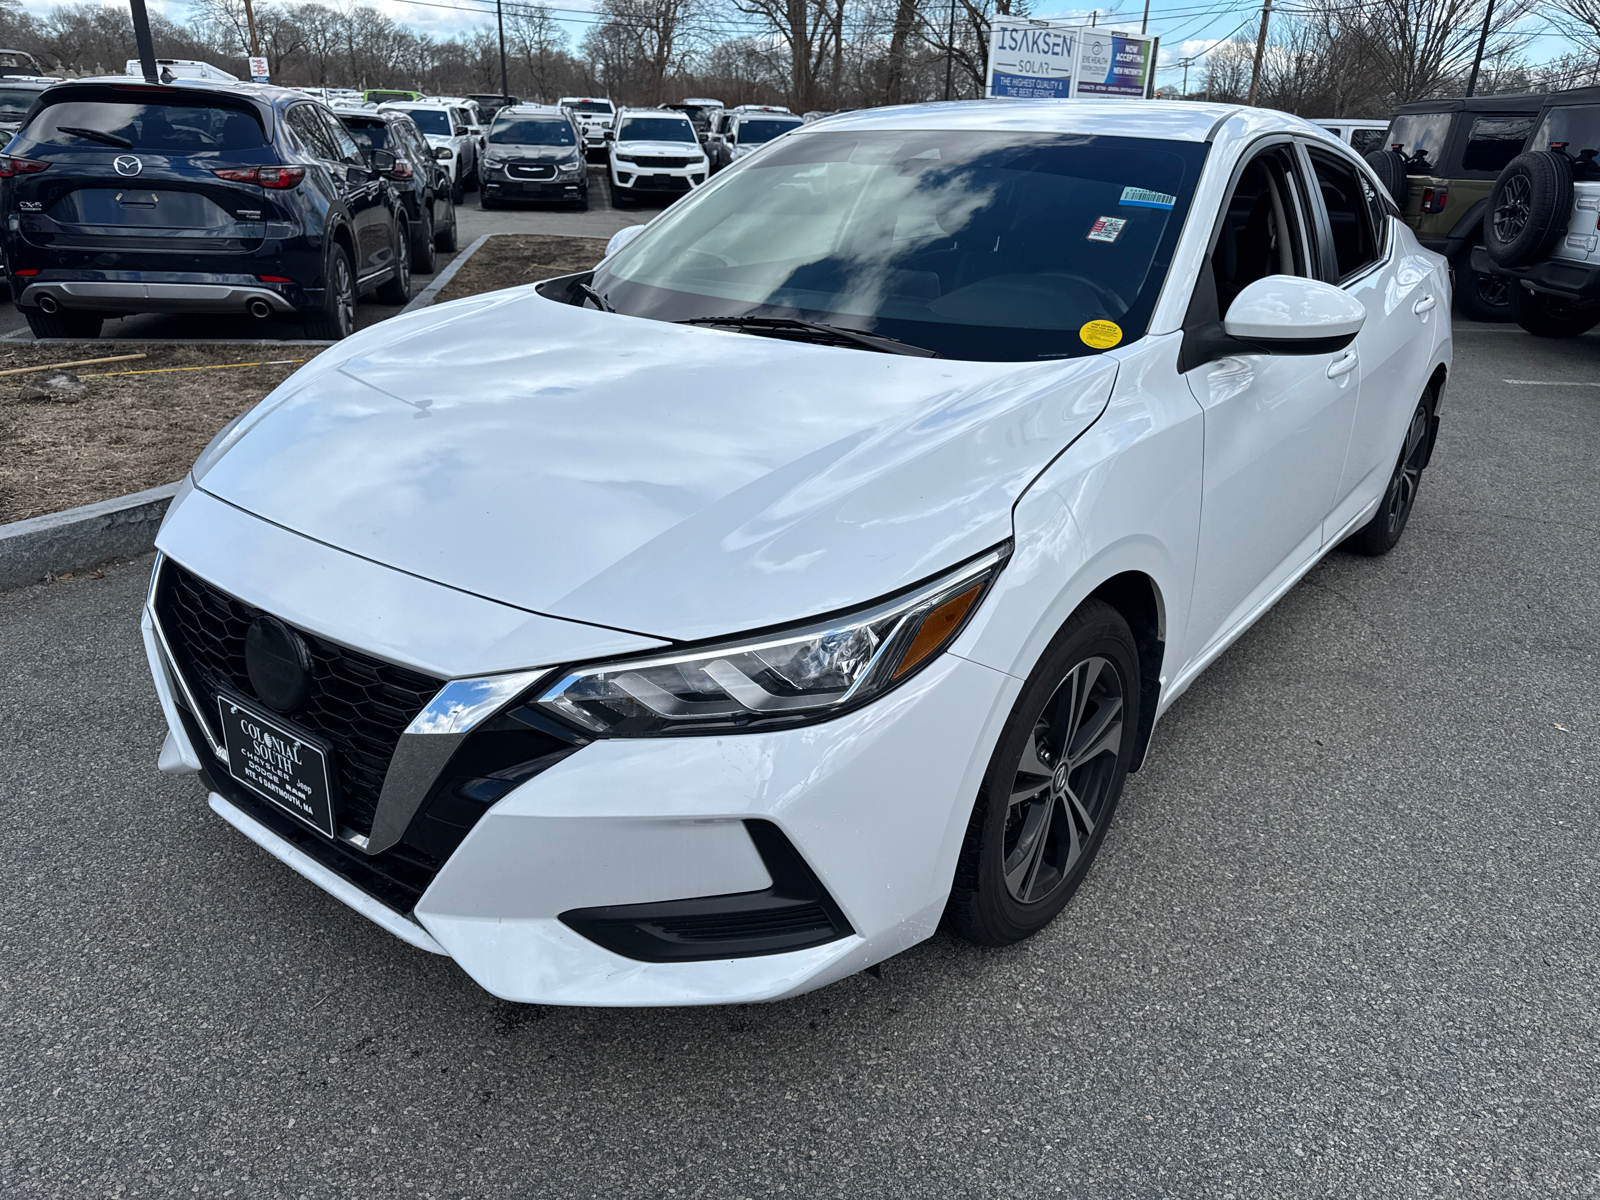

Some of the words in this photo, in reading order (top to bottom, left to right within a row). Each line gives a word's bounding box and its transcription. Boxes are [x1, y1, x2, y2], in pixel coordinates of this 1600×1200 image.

[998, 27, 1073, 57] ISAKSEN
[1124, 44, 1138, 53] NOW
[1082, 56, 1090, 64] EYE
[1091, 56, 1108, 64] HEALTH
[1116, 53, 1144, 63] ACCEPTING
[1018, 60, 1050, 74] SOLAR
[1000, 76, 1012, 86] THE
[1012, 78, 1036, 87] HIGHEST
[1036, 80, 1058, 89] QUALITY
[1058, 82, 1063, 90] &
[1007, 87, 1018, 96] THE
[1019, 88, 1033, 97] BEST
[1033, 89, 1055, 98] SERVICE
[241, 748, 290, 781] CHRYSLER
[253, 740, 294, 775] SOUTH
[248, 760, 280, 784] DODGE
[285, 783, 306, 800] RAM
[296, 779, 312, 795] Jeep
[263, 778, 302, 810] DARTMOUTH,
[303, 802, 314, 815] MA
